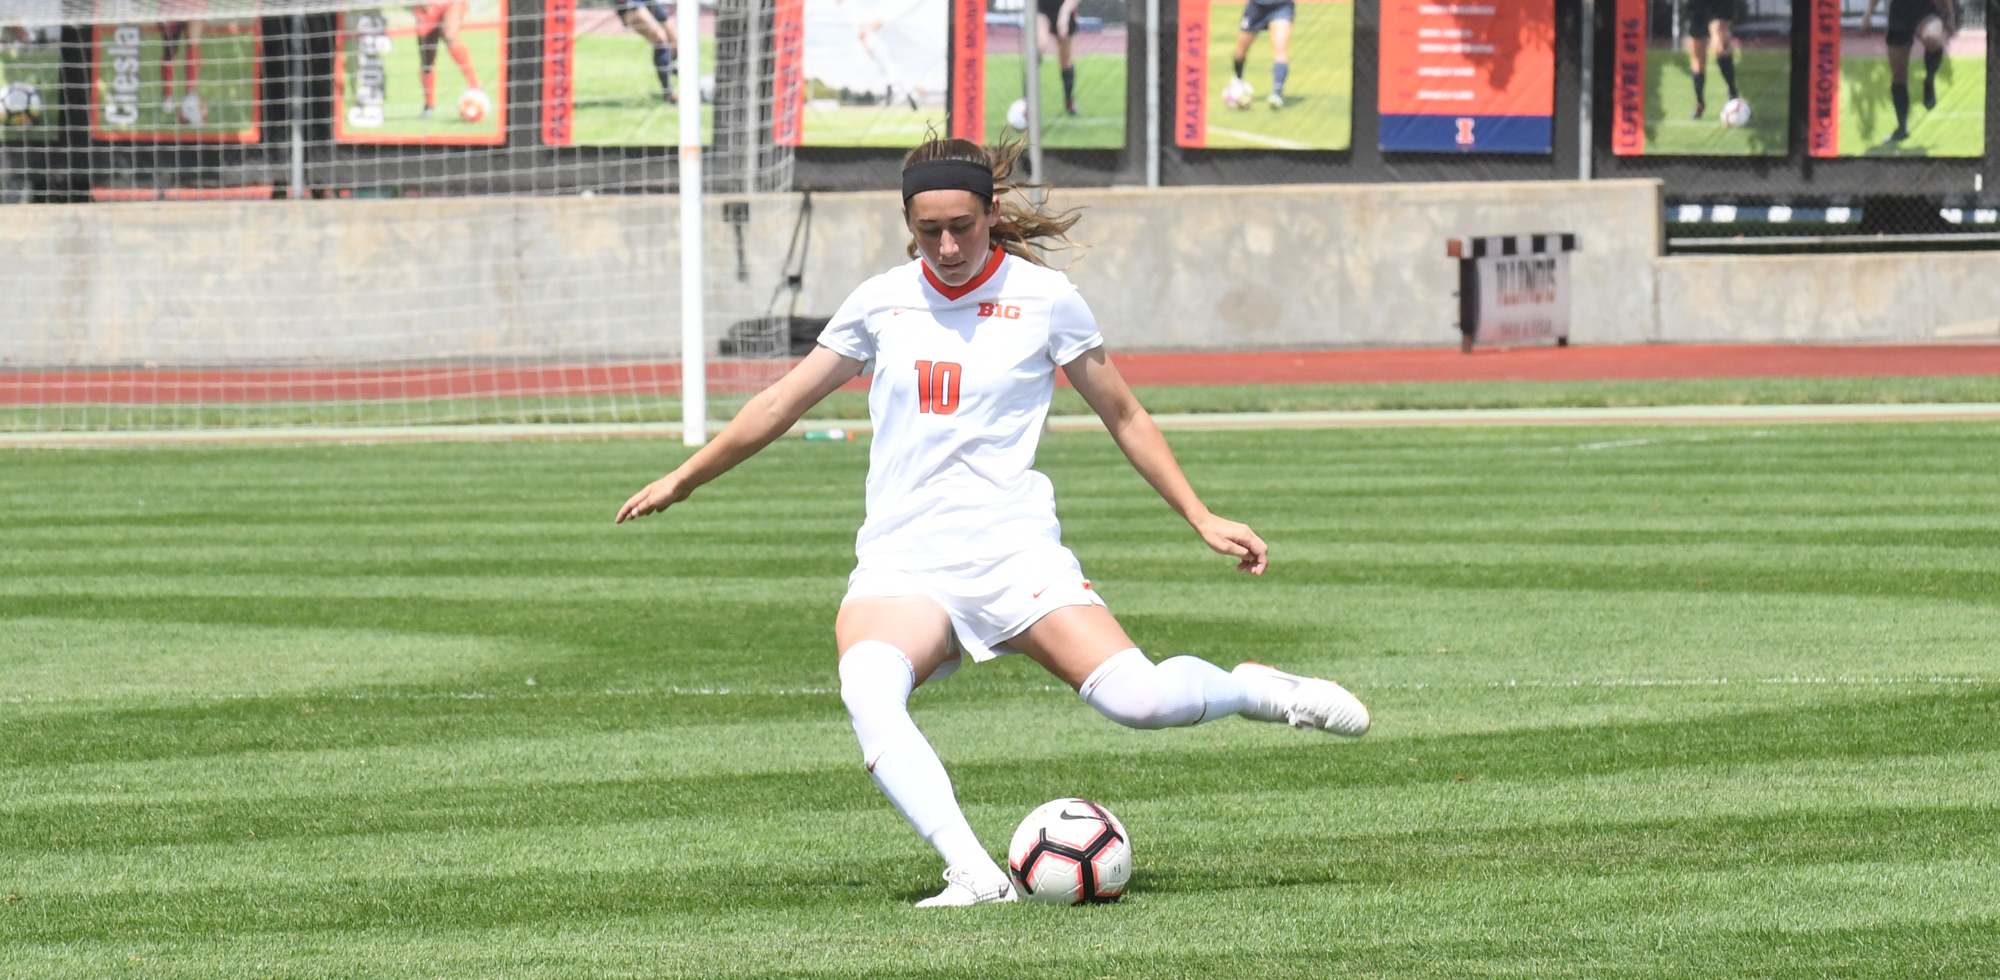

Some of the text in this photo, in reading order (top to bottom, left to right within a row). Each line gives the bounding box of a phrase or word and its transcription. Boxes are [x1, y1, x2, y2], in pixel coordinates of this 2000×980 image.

[105, 25, 140, 124] Ciesla
[348, 14, 392, 128] George
[1184, 23, 1202, 140] MADAY #15
[1621, 18, 1638, 147] LEFEVRE #16
[915, 360, 962, 415] 10
